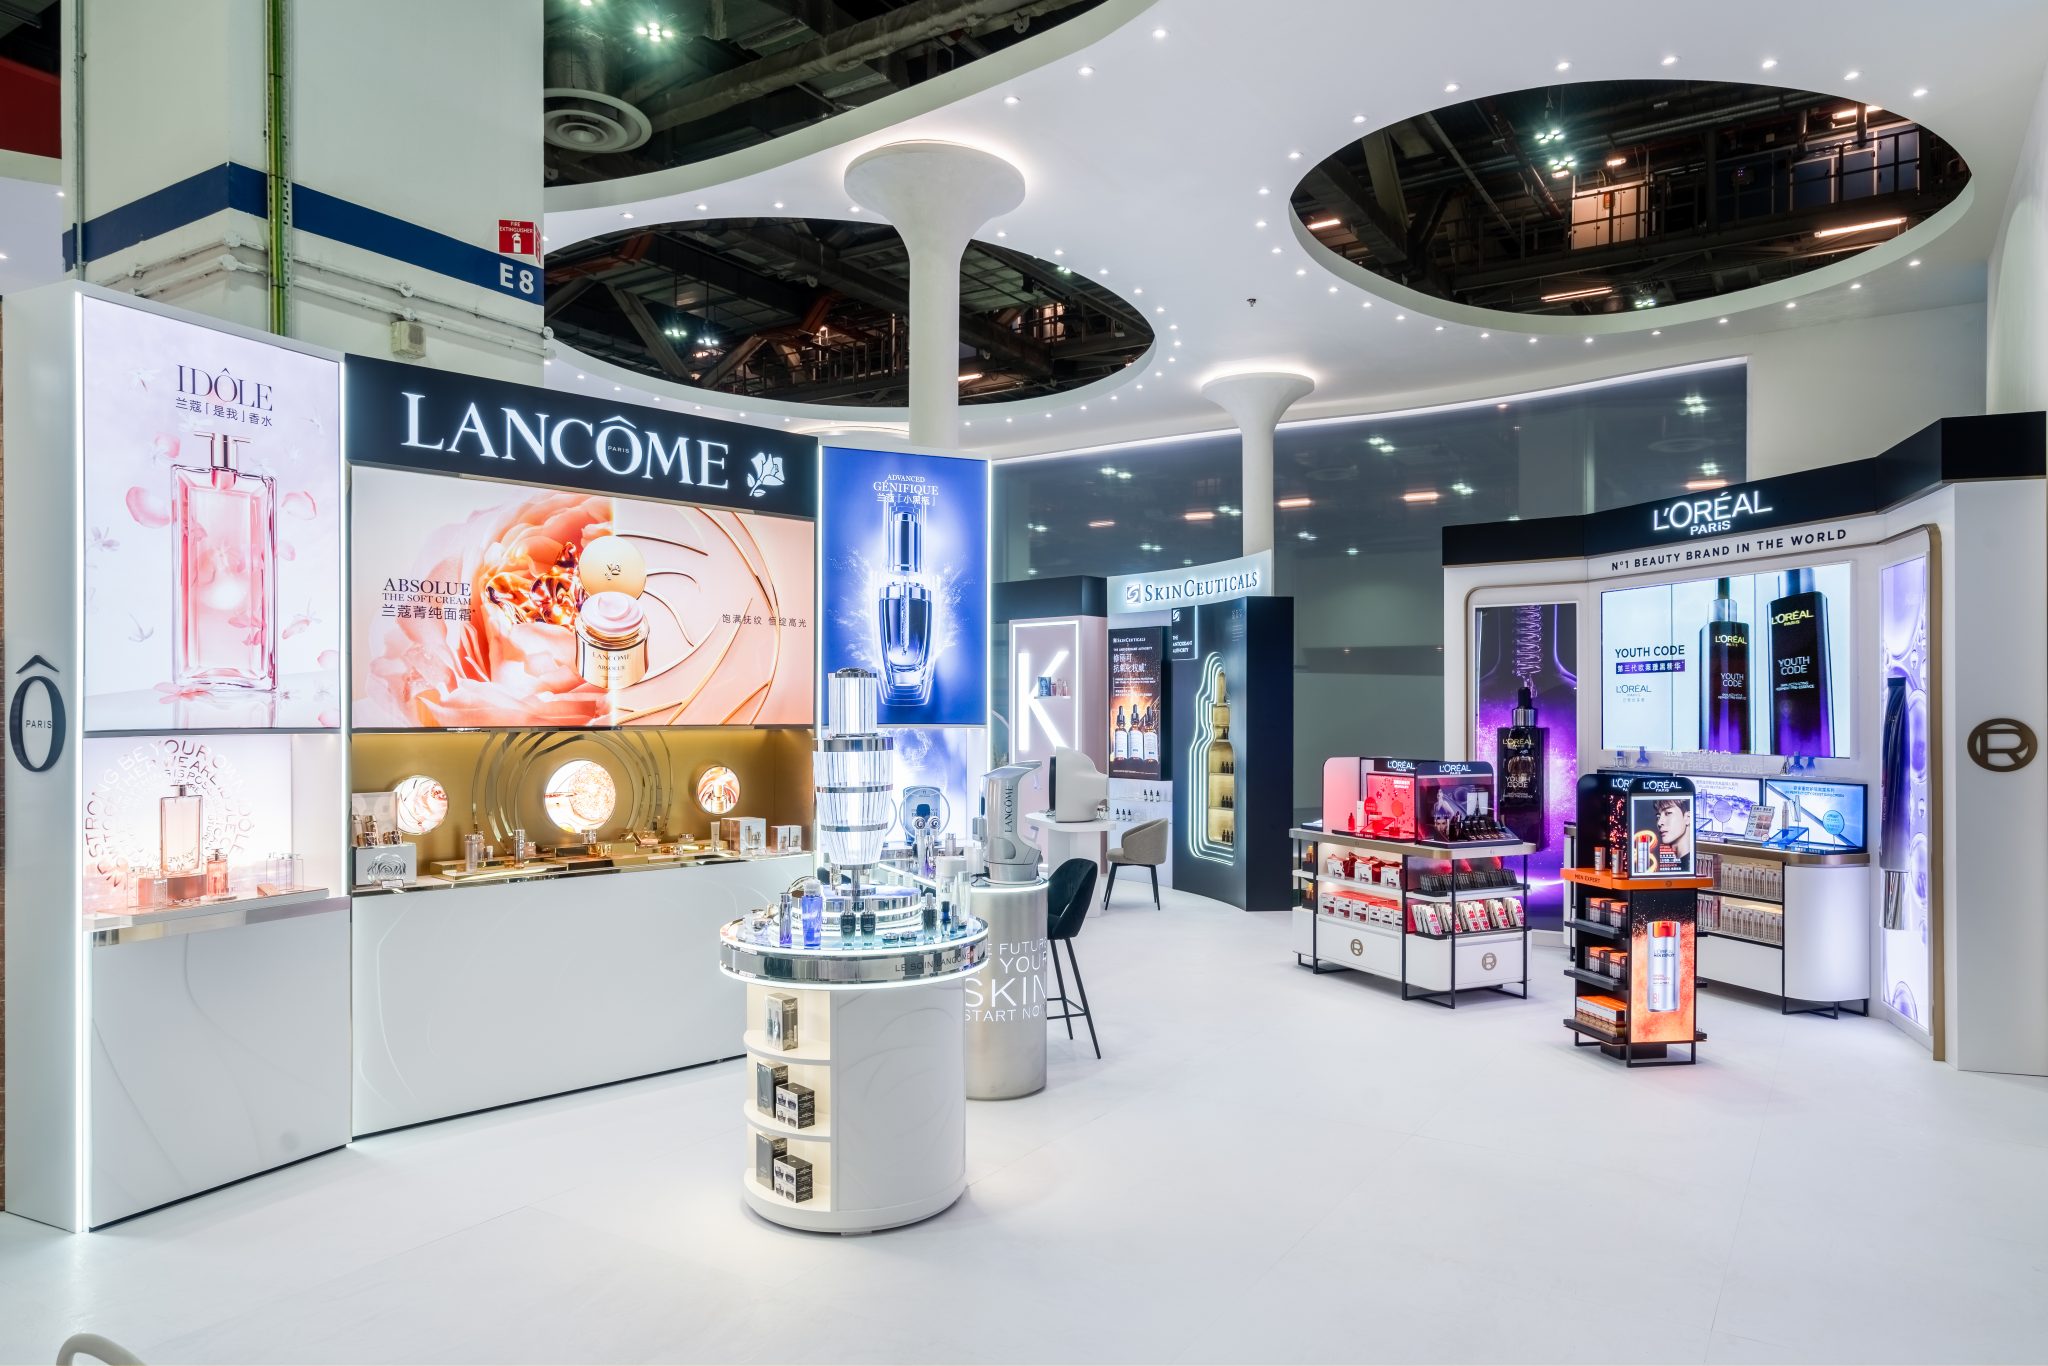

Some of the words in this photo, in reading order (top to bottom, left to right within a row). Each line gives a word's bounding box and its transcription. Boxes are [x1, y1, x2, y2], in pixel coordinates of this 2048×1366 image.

[499, 226, 534, 234] EXTINGUISHER
[176, 363, 273, 412] IDÔLE
[400, 391, 730, 490] LANCÔME
[607, 445, 630, 454] PARIS
[887, 474, 926, 483] ADVANCED
[873, 480, 939, 496] GÉNIFIQUE
[1652, 490, 1774, 532] L'ORÉAL
[1634, 552, 1681, 568] BEAUTY
[1686, 545, 1731, 561] BRAND
[1736, 542, 1751, 554] IN
[1756, 537, 1785, 550] THE
[1791, 529, 1848, 547] WORLD
[383, 577, 472, 597] ABSOLUE
[382, 592, 405, 602] THE
[407, 594, 434, 603] SOFT
[435, 595, 472, 606] CREAM
[1771, 609, 1815, 625] L'ORÉAL
[1714, 634, 1748, 645] L'ORÉAL
[1615, 646, 1651, 659] YOUTH
[1653, 644, 1686, 657] CODE
[1777, 656, 1811, 667] YOUTH
[1780, 664, 1809, 676] CODE
[1720, 672, 1745, 681] YOUTH
[1722, 679, 1743, 688] CODE
[25, 719, 53, 729] PARIS
[1387, 760, 1416, 770] L'ORÉAL
[1439, 763, 1472, 773] L'ORÉAL
[1643, 779, 1682, 790] L'ORÉAL
